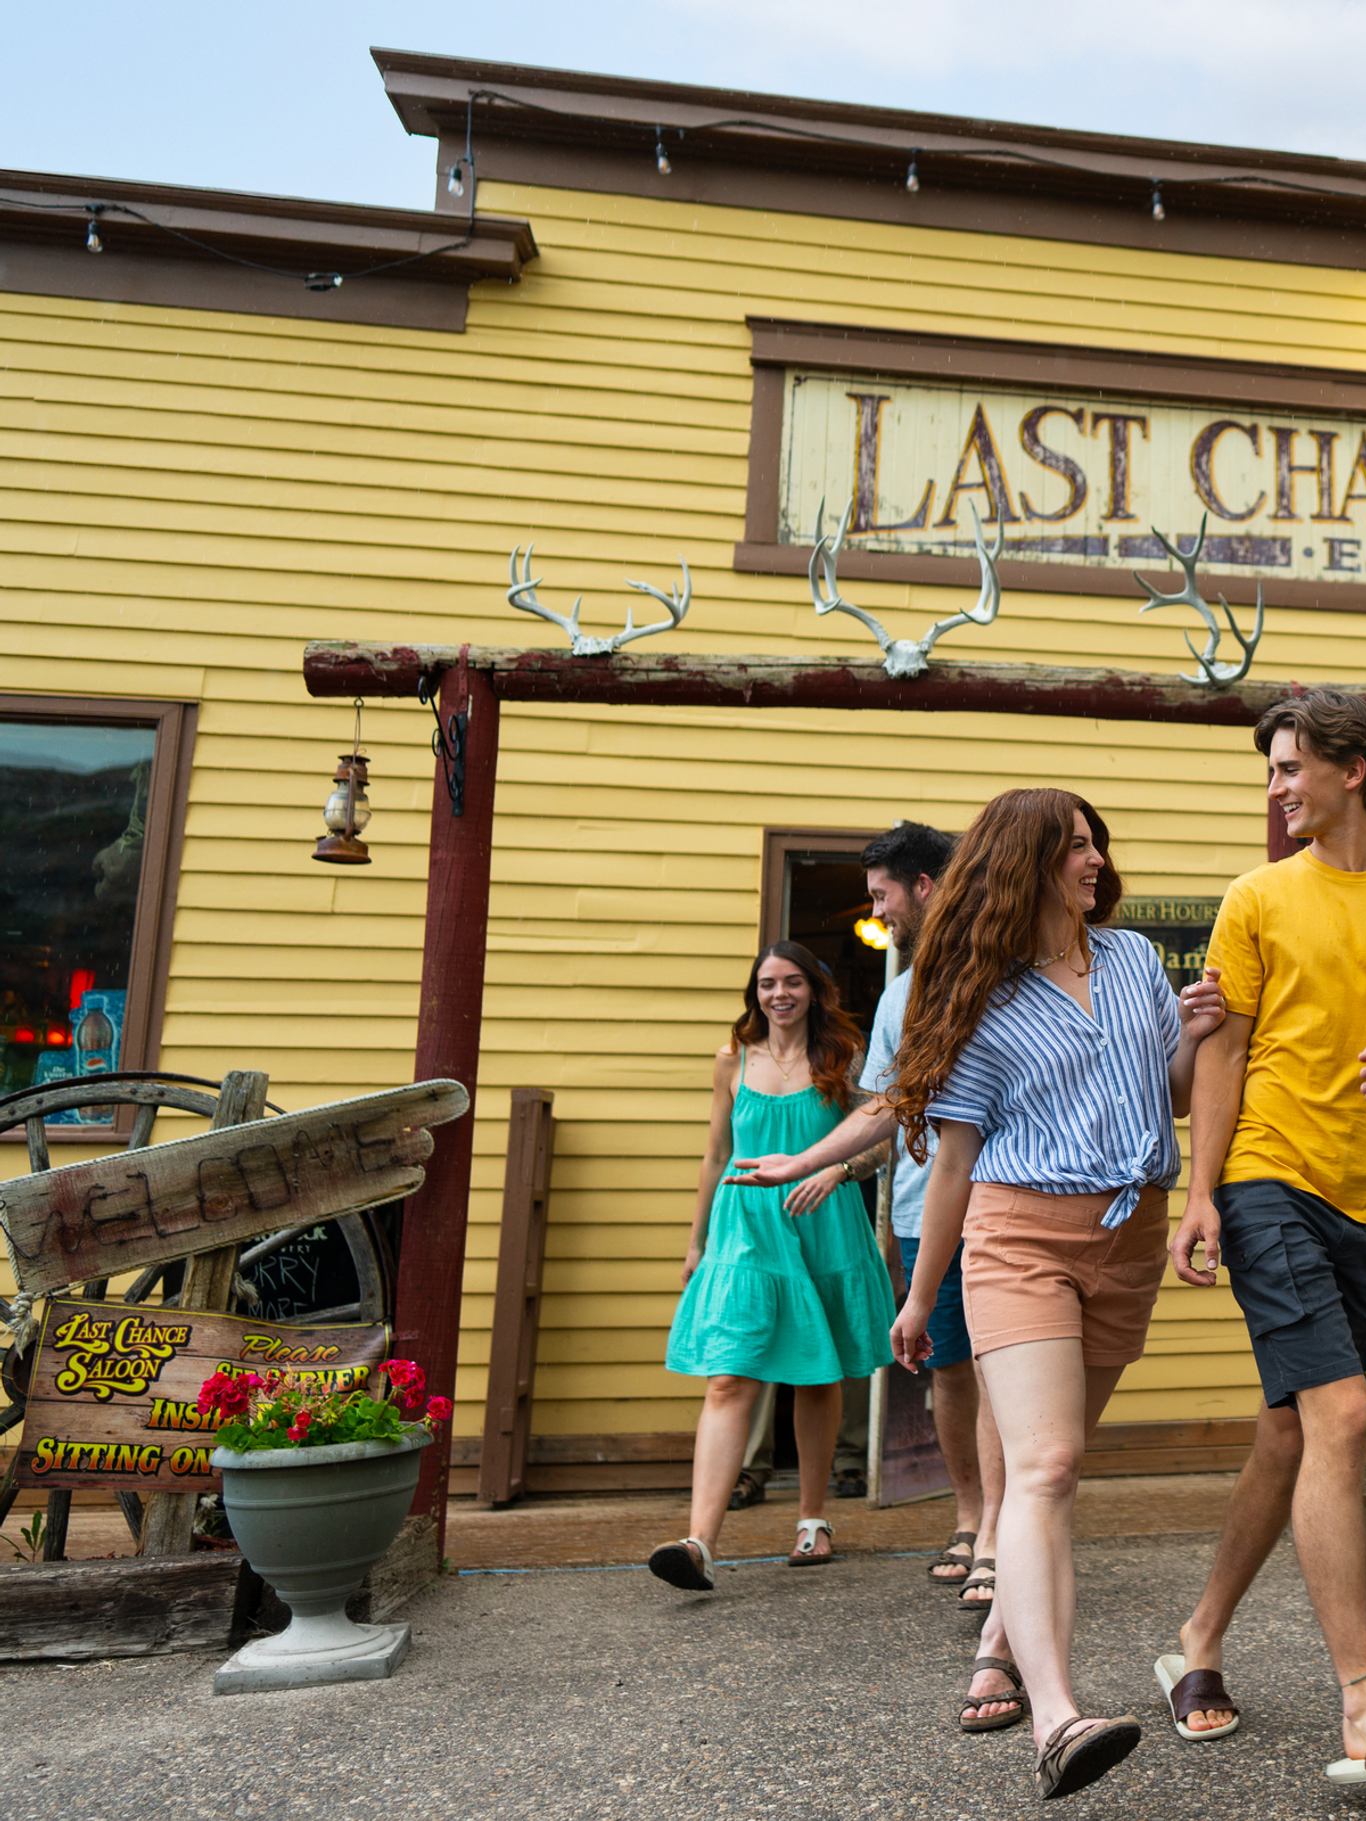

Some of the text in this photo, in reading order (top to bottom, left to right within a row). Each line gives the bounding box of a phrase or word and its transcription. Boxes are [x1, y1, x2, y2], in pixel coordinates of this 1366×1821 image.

[845, 391, 1150, 536] LAST
[53, 1312, 191, 1359] LAST CHANCE
[239, 1334, 343, 1362] Please
[55, 1350, 162, 1400] SALOON
[31, 1436, 163, 1476] SITTING
